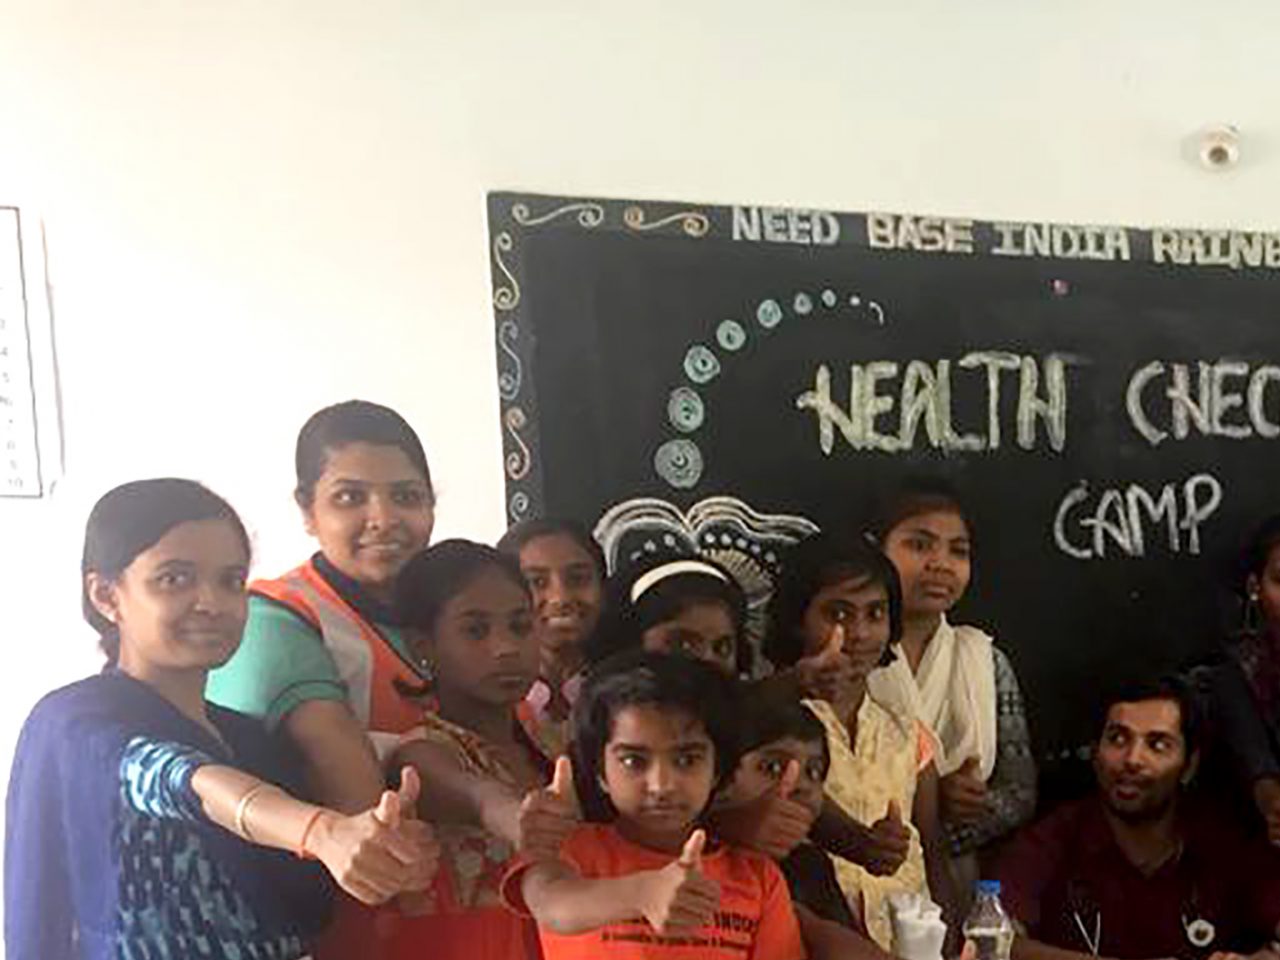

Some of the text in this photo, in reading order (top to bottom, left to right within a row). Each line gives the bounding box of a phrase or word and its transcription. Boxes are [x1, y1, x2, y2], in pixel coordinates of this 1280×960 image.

[731, 206, 840, 245] NEED
[865, 212, 975, 254] BASE
[991, 221, 1131, 261] INDIA
[797, 350, 1068, 453] HEALTH
